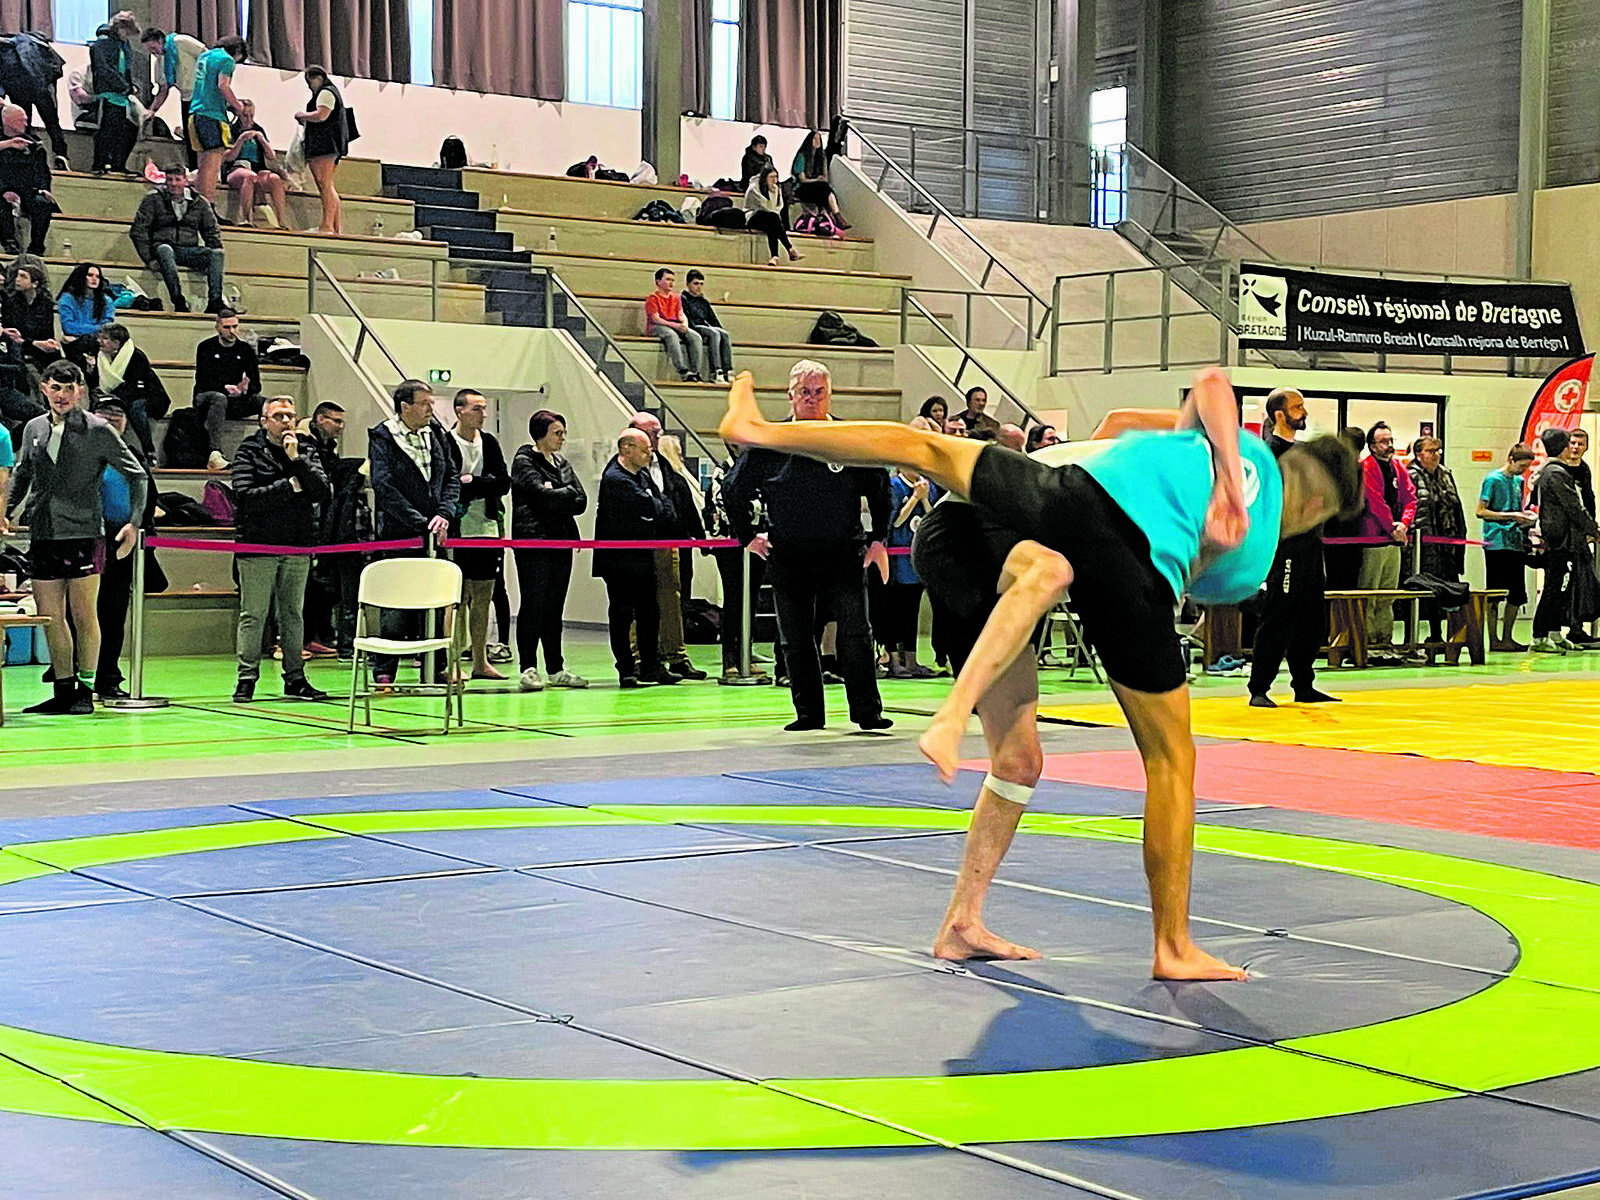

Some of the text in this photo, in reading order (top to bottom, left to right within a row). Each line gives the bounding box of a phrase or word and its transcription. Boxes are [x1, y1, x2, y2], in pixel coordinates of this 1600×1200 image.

[1298, 289, 1563, 329] Conseil régional de Bretagne
[1238, 324, 1287, 336] BRETAGNE
[1383, 331, 1418, 346] Breizh
[1506, 336, 1520, 349] de
